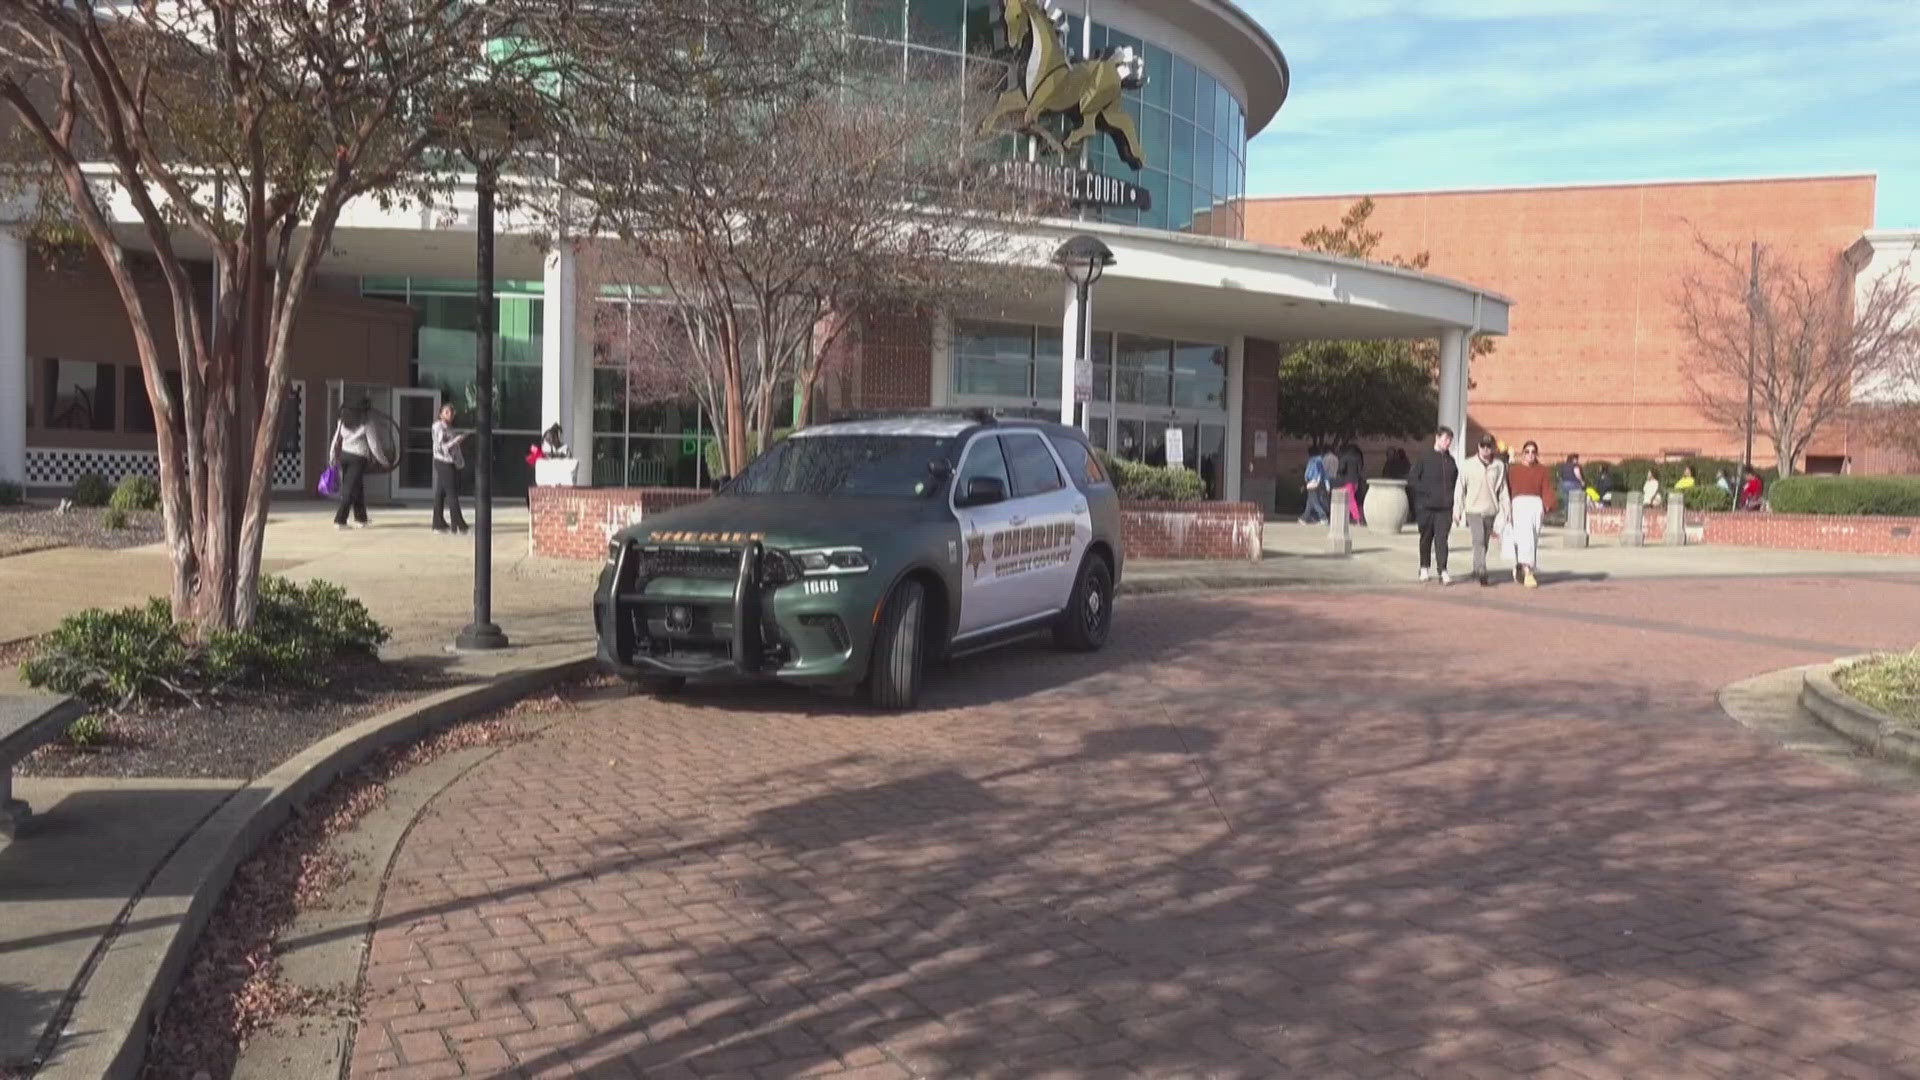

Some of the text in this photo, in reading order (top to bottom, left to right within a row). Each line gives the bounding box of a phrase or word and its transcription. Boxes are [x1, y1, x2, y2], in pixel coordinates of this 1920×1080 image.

[1004, 160, 1124, 205] CAROUSEL COURT
[648, 530, 765, 543] SHERIFF
[992, 520, 1075, 559] SHERIFF
